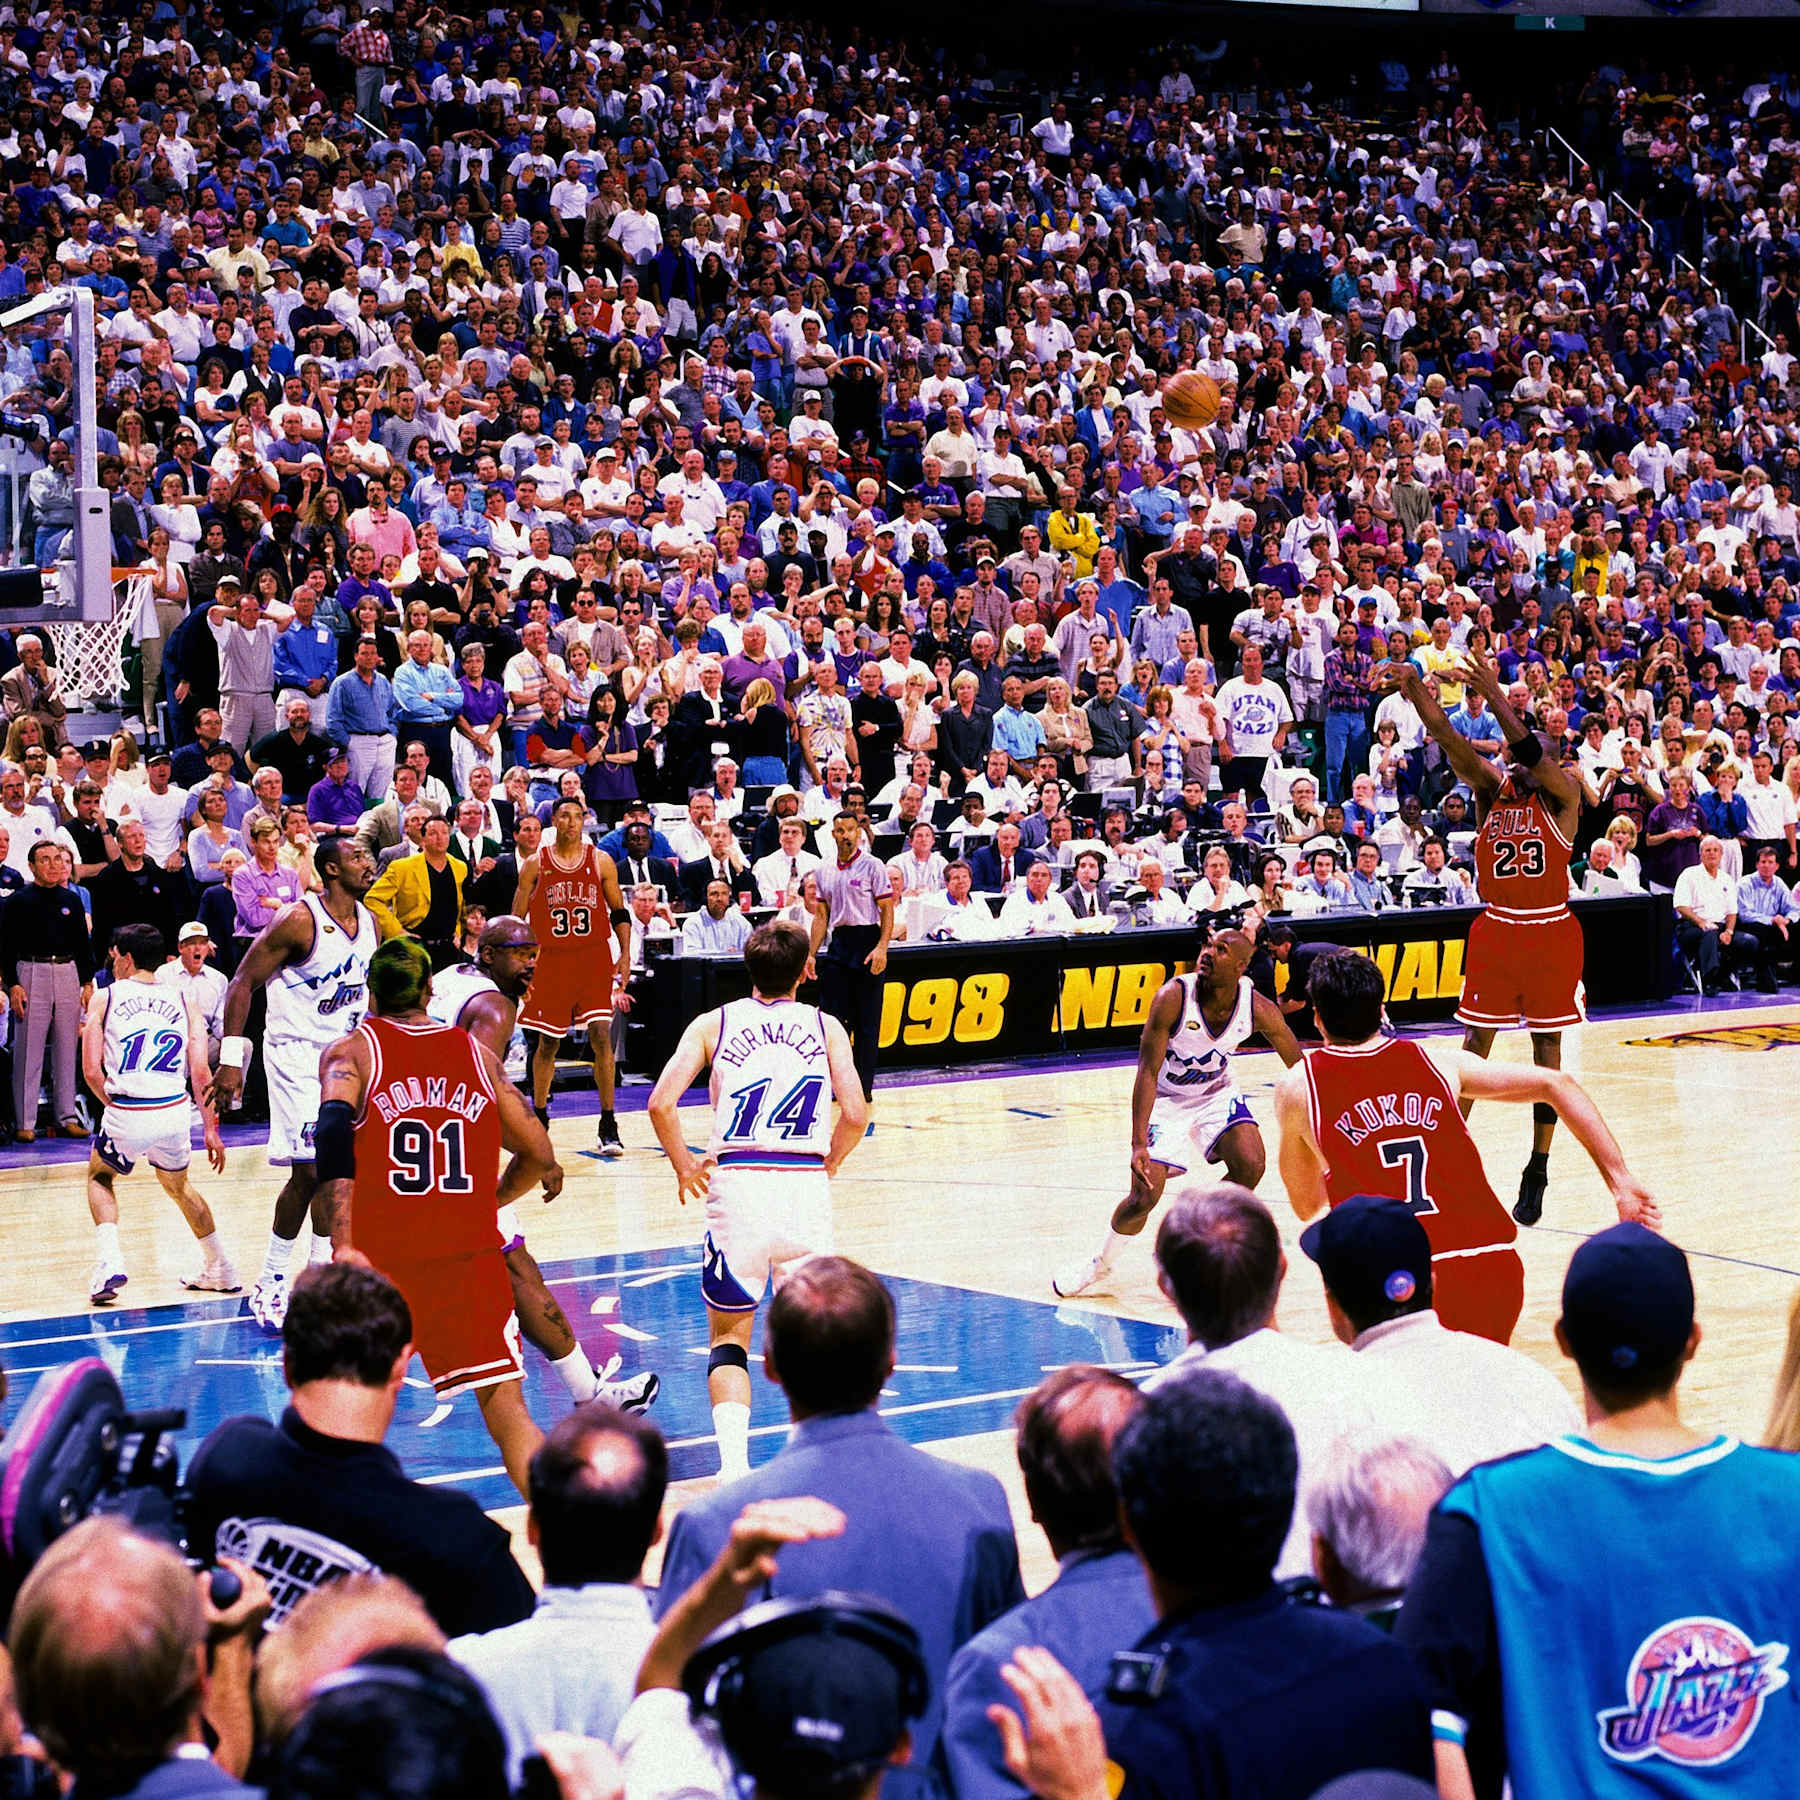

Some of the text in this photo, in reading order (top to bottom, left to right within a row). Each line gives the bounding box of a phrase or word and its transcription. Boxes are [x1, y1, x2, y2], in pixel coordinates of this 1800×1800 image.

[1545, 16, 1556, 29] K
[1233, 694, 1276, 713] UTAH
[1234, 720, 1274, 735] JAZZ
[1493, 838, 1546, 879] 23
[550, 905, 592, 938] 33
[113, 996, 184, 1026] STOCKTON
[1051, 961, 1198, 1033] NB
[118, 1027, 186, 1076] 12
[721, 1022, 826, 1068] HORNACEK
[372, 1076, 490, 1125] RODMAN
[722, 1074, 826, 1143] 14
[1334, 1092, 1444, 1148] KUKOC
[387, 1117, 475, 1197] 91
[1376, 1134, 1441, 1217] 7
